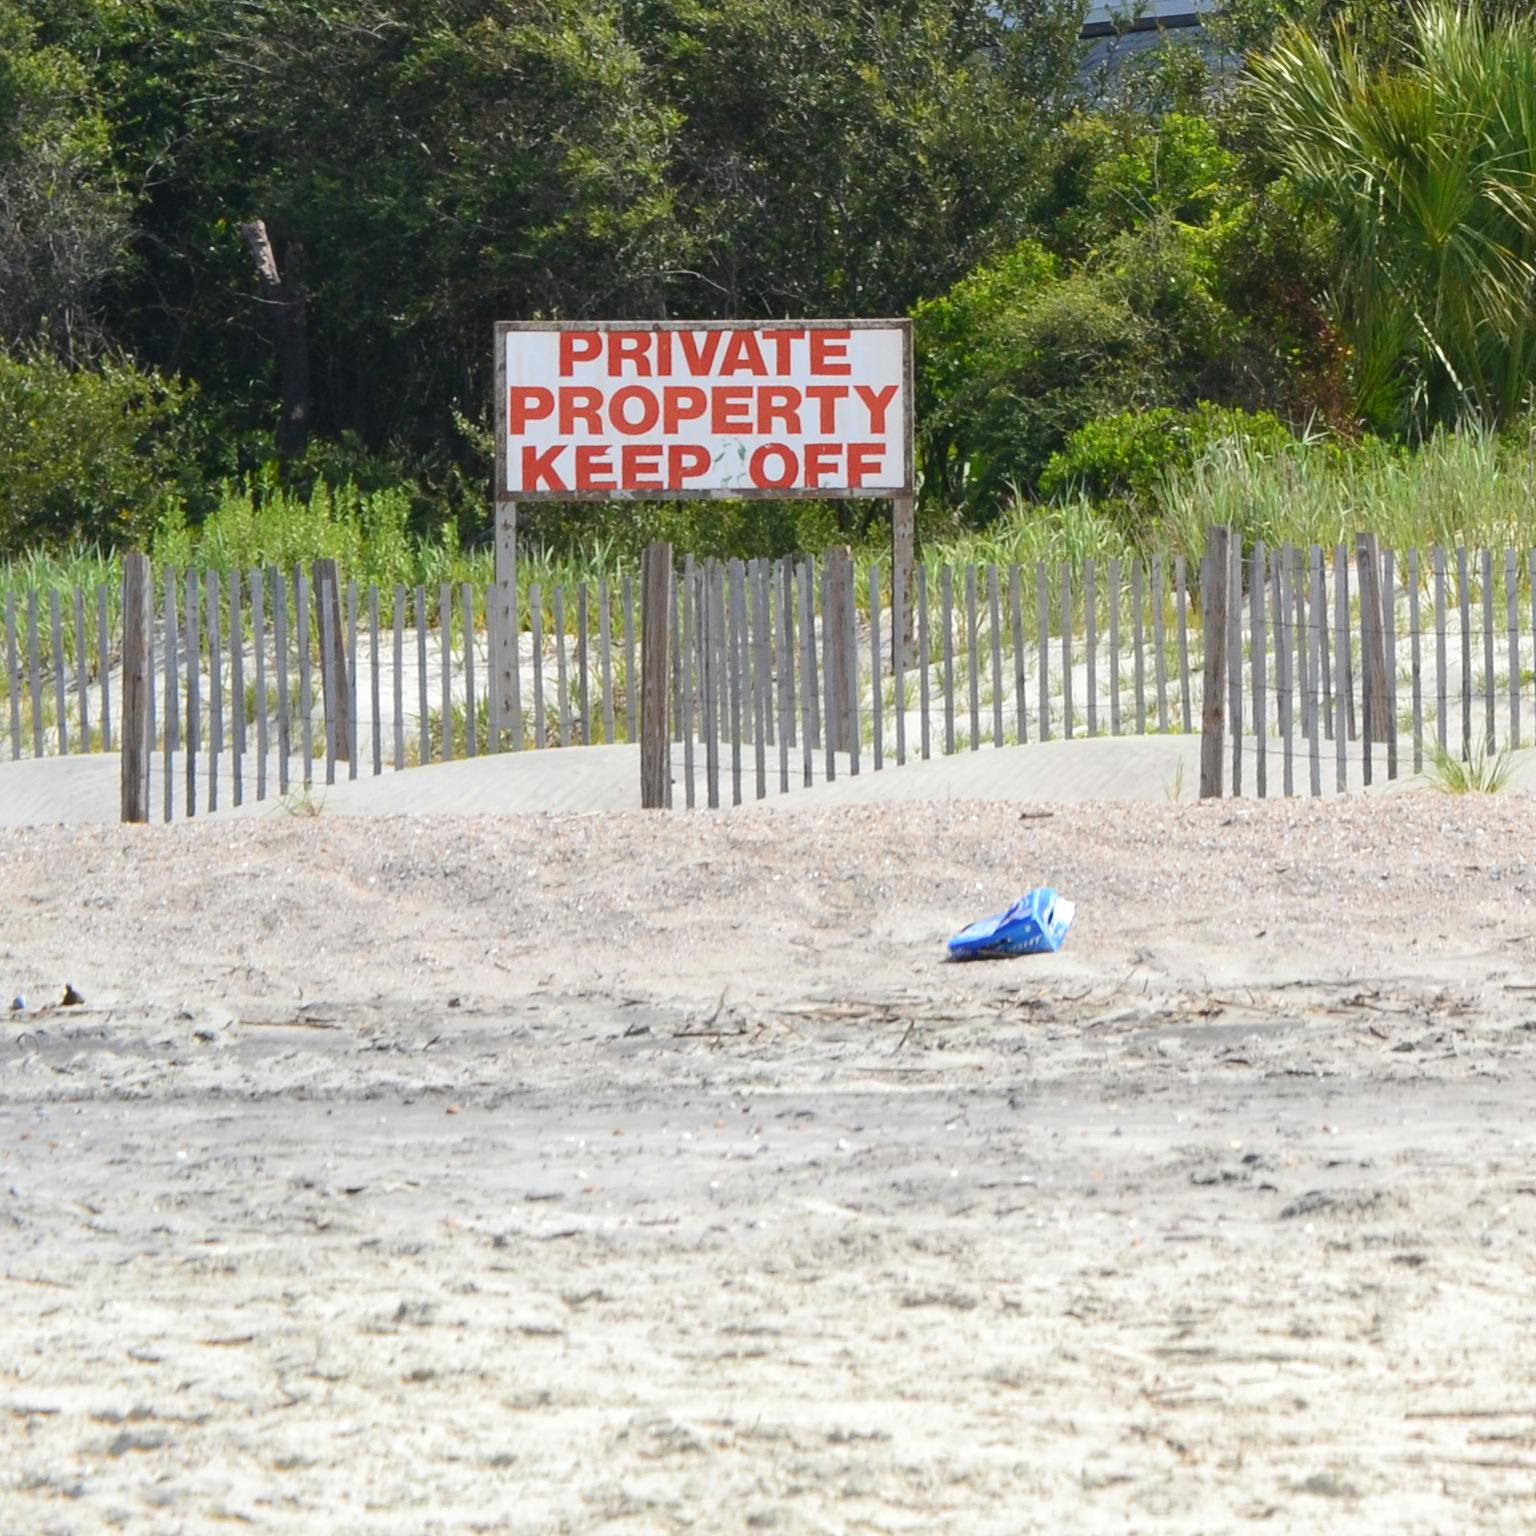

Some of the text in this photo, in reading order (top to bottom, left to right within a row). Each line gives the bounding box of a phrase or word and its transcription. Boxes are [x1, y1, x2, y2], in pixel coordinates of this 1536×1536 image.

[559, 329, 852, 377] PRIVATE
[510, 384, 899, 435] PROPERTY
[521, 442, 887, 491] KEEP OFF
